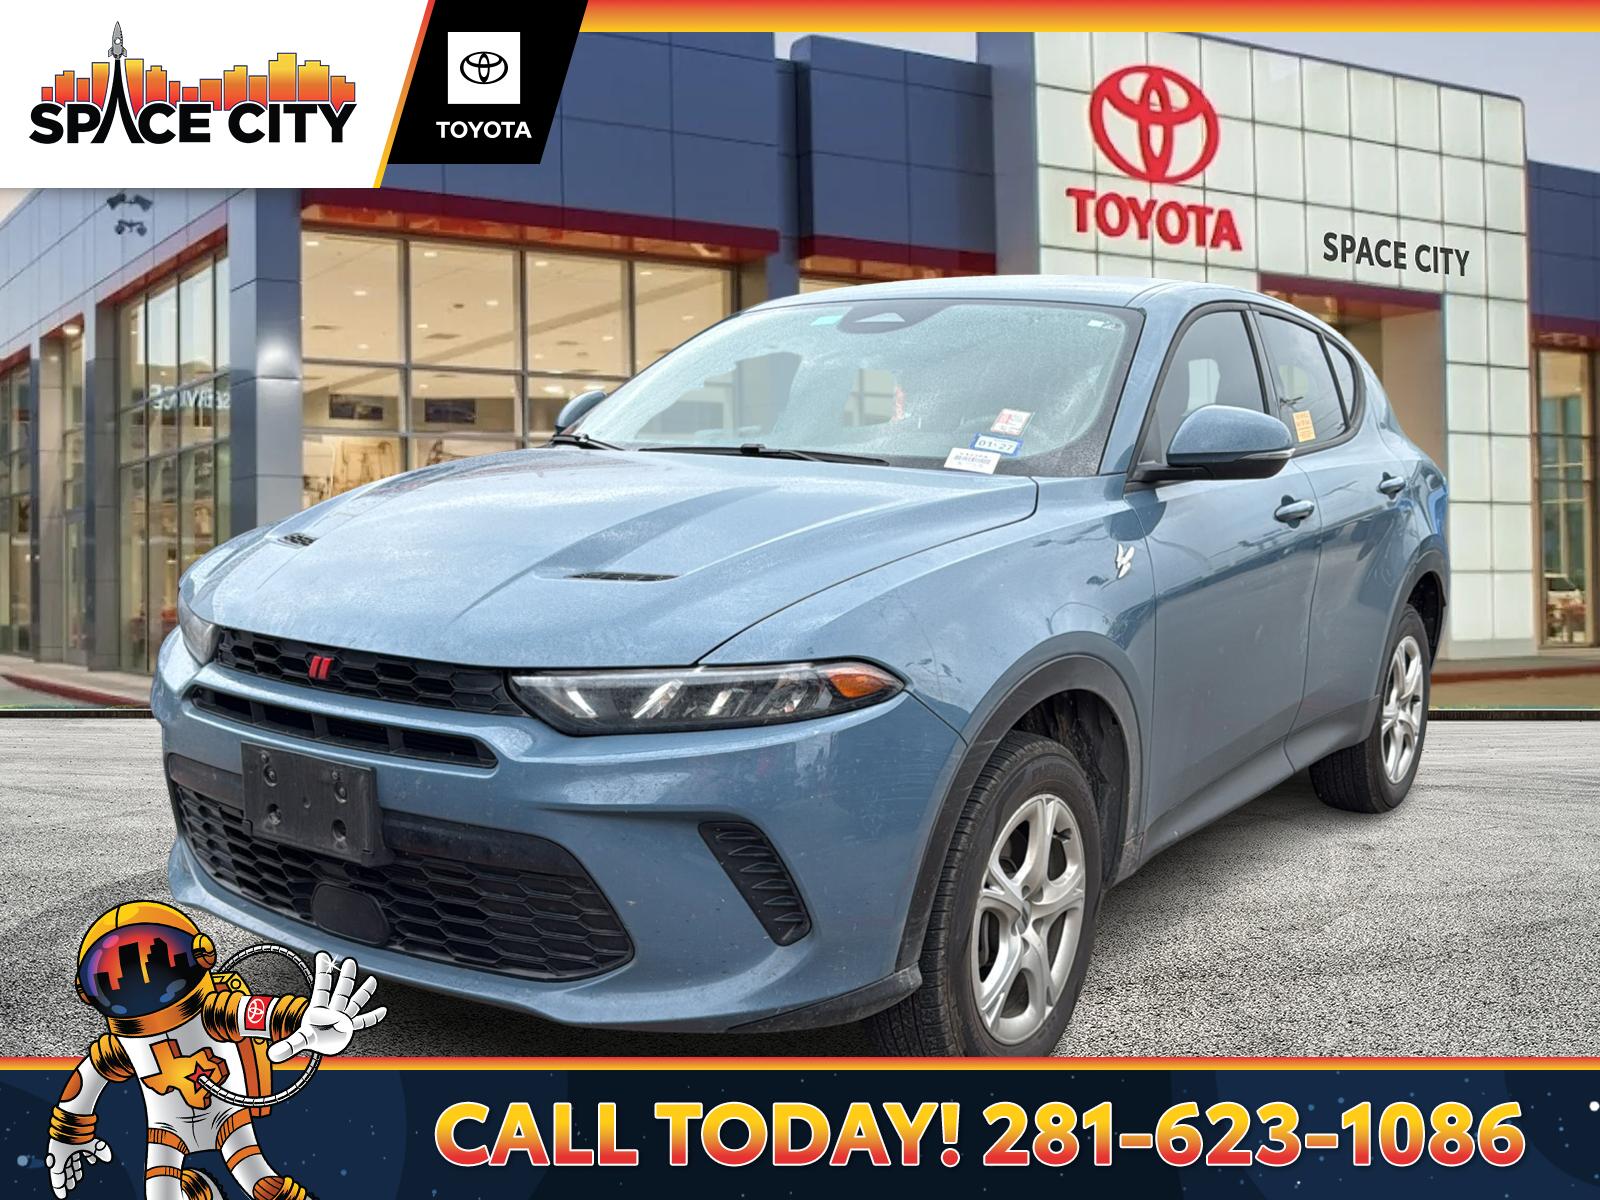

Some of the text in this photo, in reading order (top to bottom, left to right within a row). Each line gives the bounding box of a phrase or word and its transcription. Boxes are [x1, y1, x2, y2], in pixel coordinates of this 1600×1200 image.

[1066, 188, 1242, 251] TOYOTA
[1323, 232, 1470, 276] SPACE CITY
